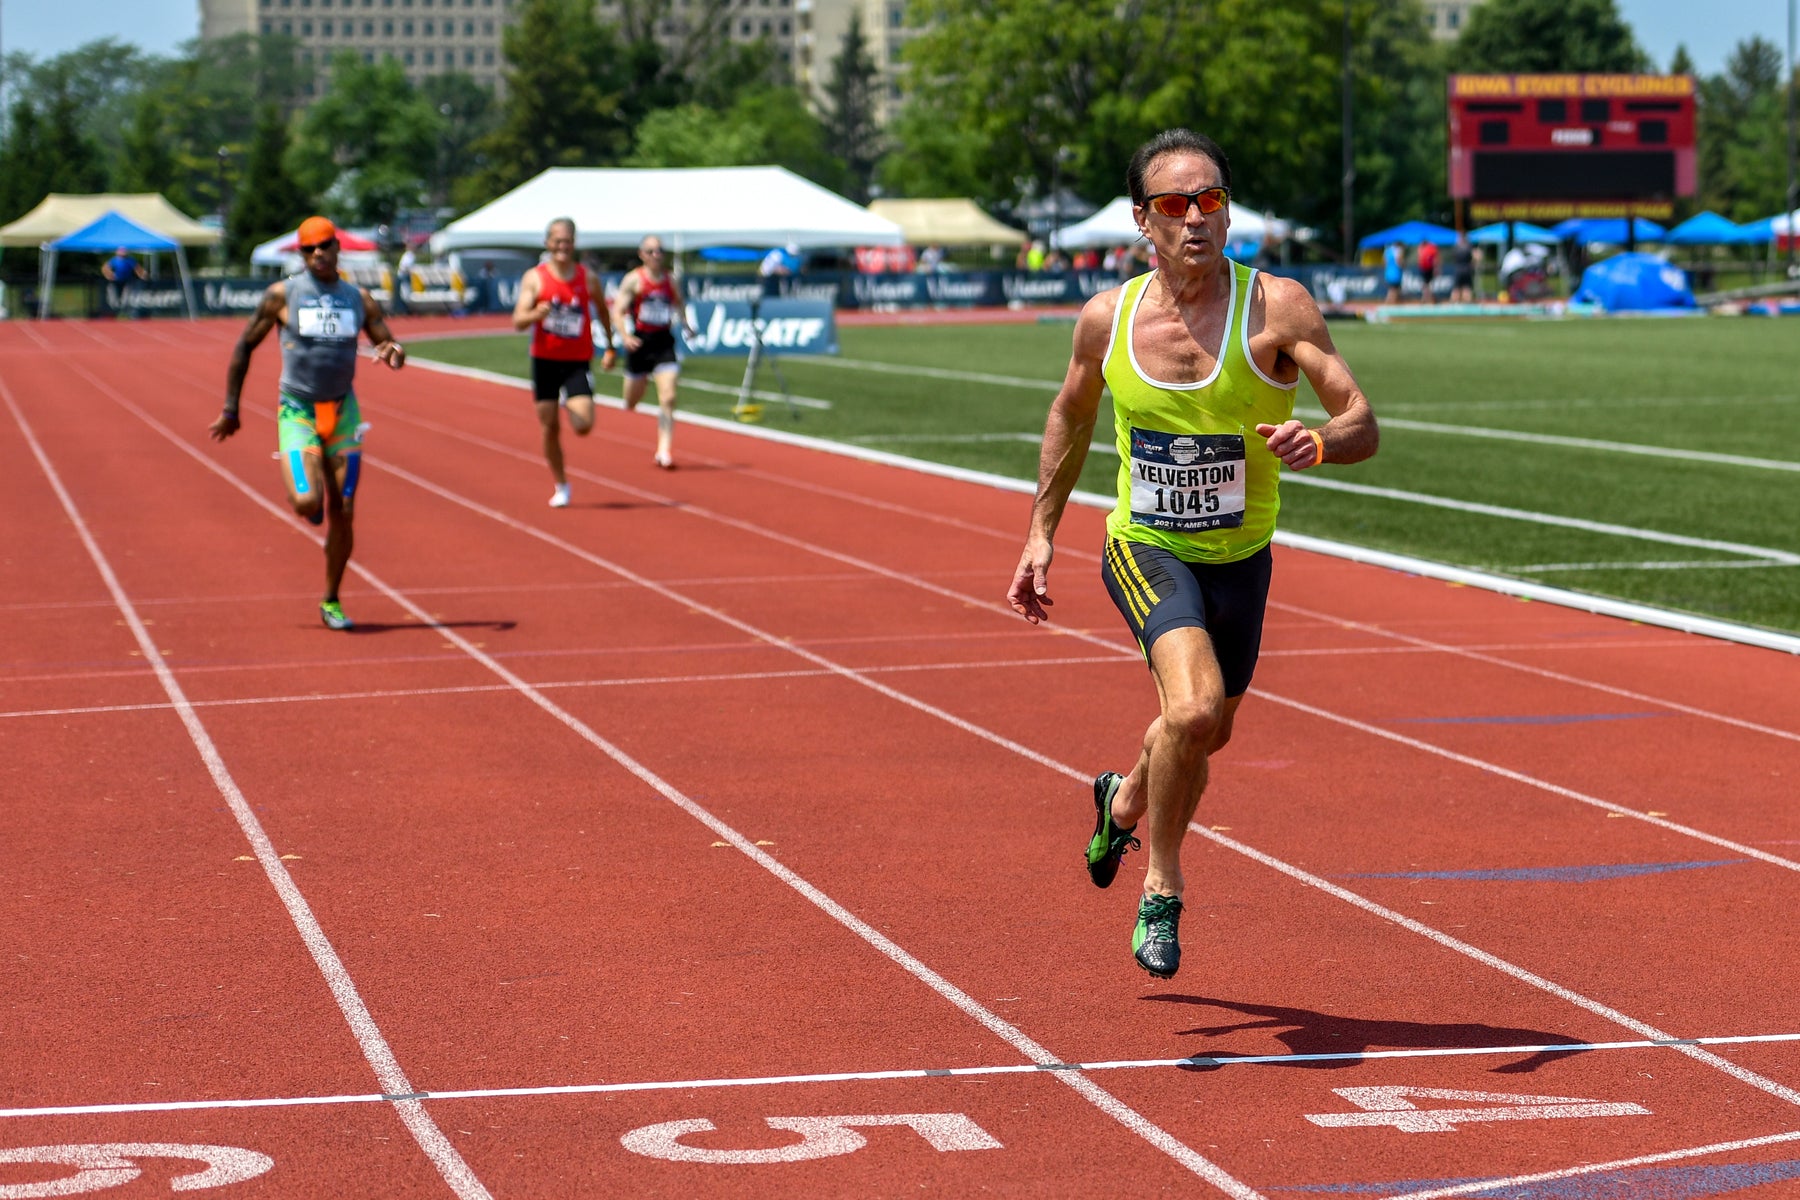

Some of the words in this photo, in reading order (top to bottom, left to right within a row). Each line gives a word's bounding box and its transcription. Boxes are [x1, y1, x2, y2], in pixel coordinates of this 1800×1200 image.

[719, 317, 826, 347] USATF
[1138, 463, 1235, 487] YELVERTON
[1155, 488, 1220, 515] 1045
[1154, 519, 1173, 527] 2021
[1184, 520, 1210, 529] AMES,
[1304, 1085, 1653, 1133] 4
[620, 1112, 1005, 1164] 5
